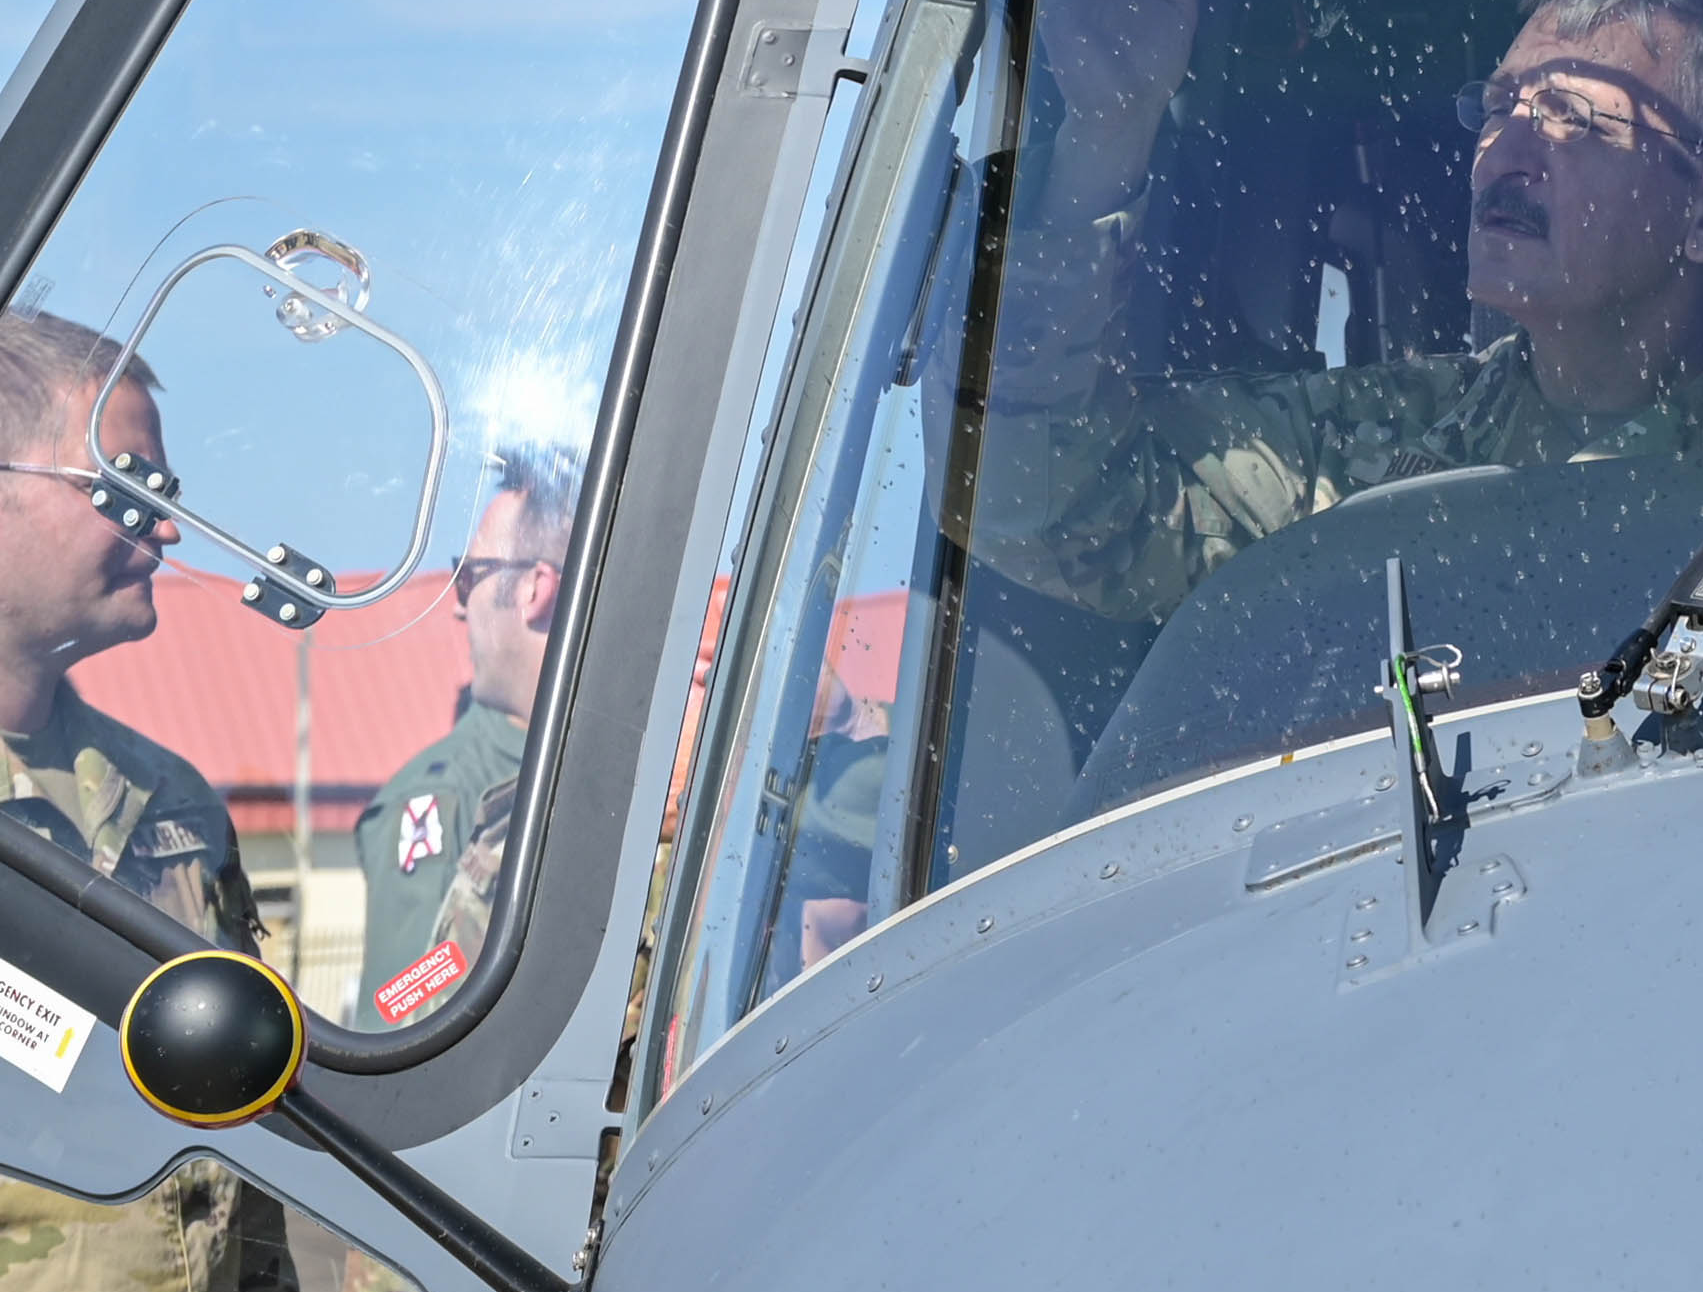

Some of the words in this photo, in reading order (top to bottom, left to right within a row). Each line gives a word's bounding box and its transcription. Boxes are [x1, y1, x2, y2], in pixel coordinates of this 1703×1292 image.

[378, 944, 451, 1003] EMERGENCY
[390, 988, 424, 1018] PUSH
[425, 962, 459, 992] HERE
[36, 1005, 62, 1027] EXIT
[37, 1031, 50, 1044] AT
